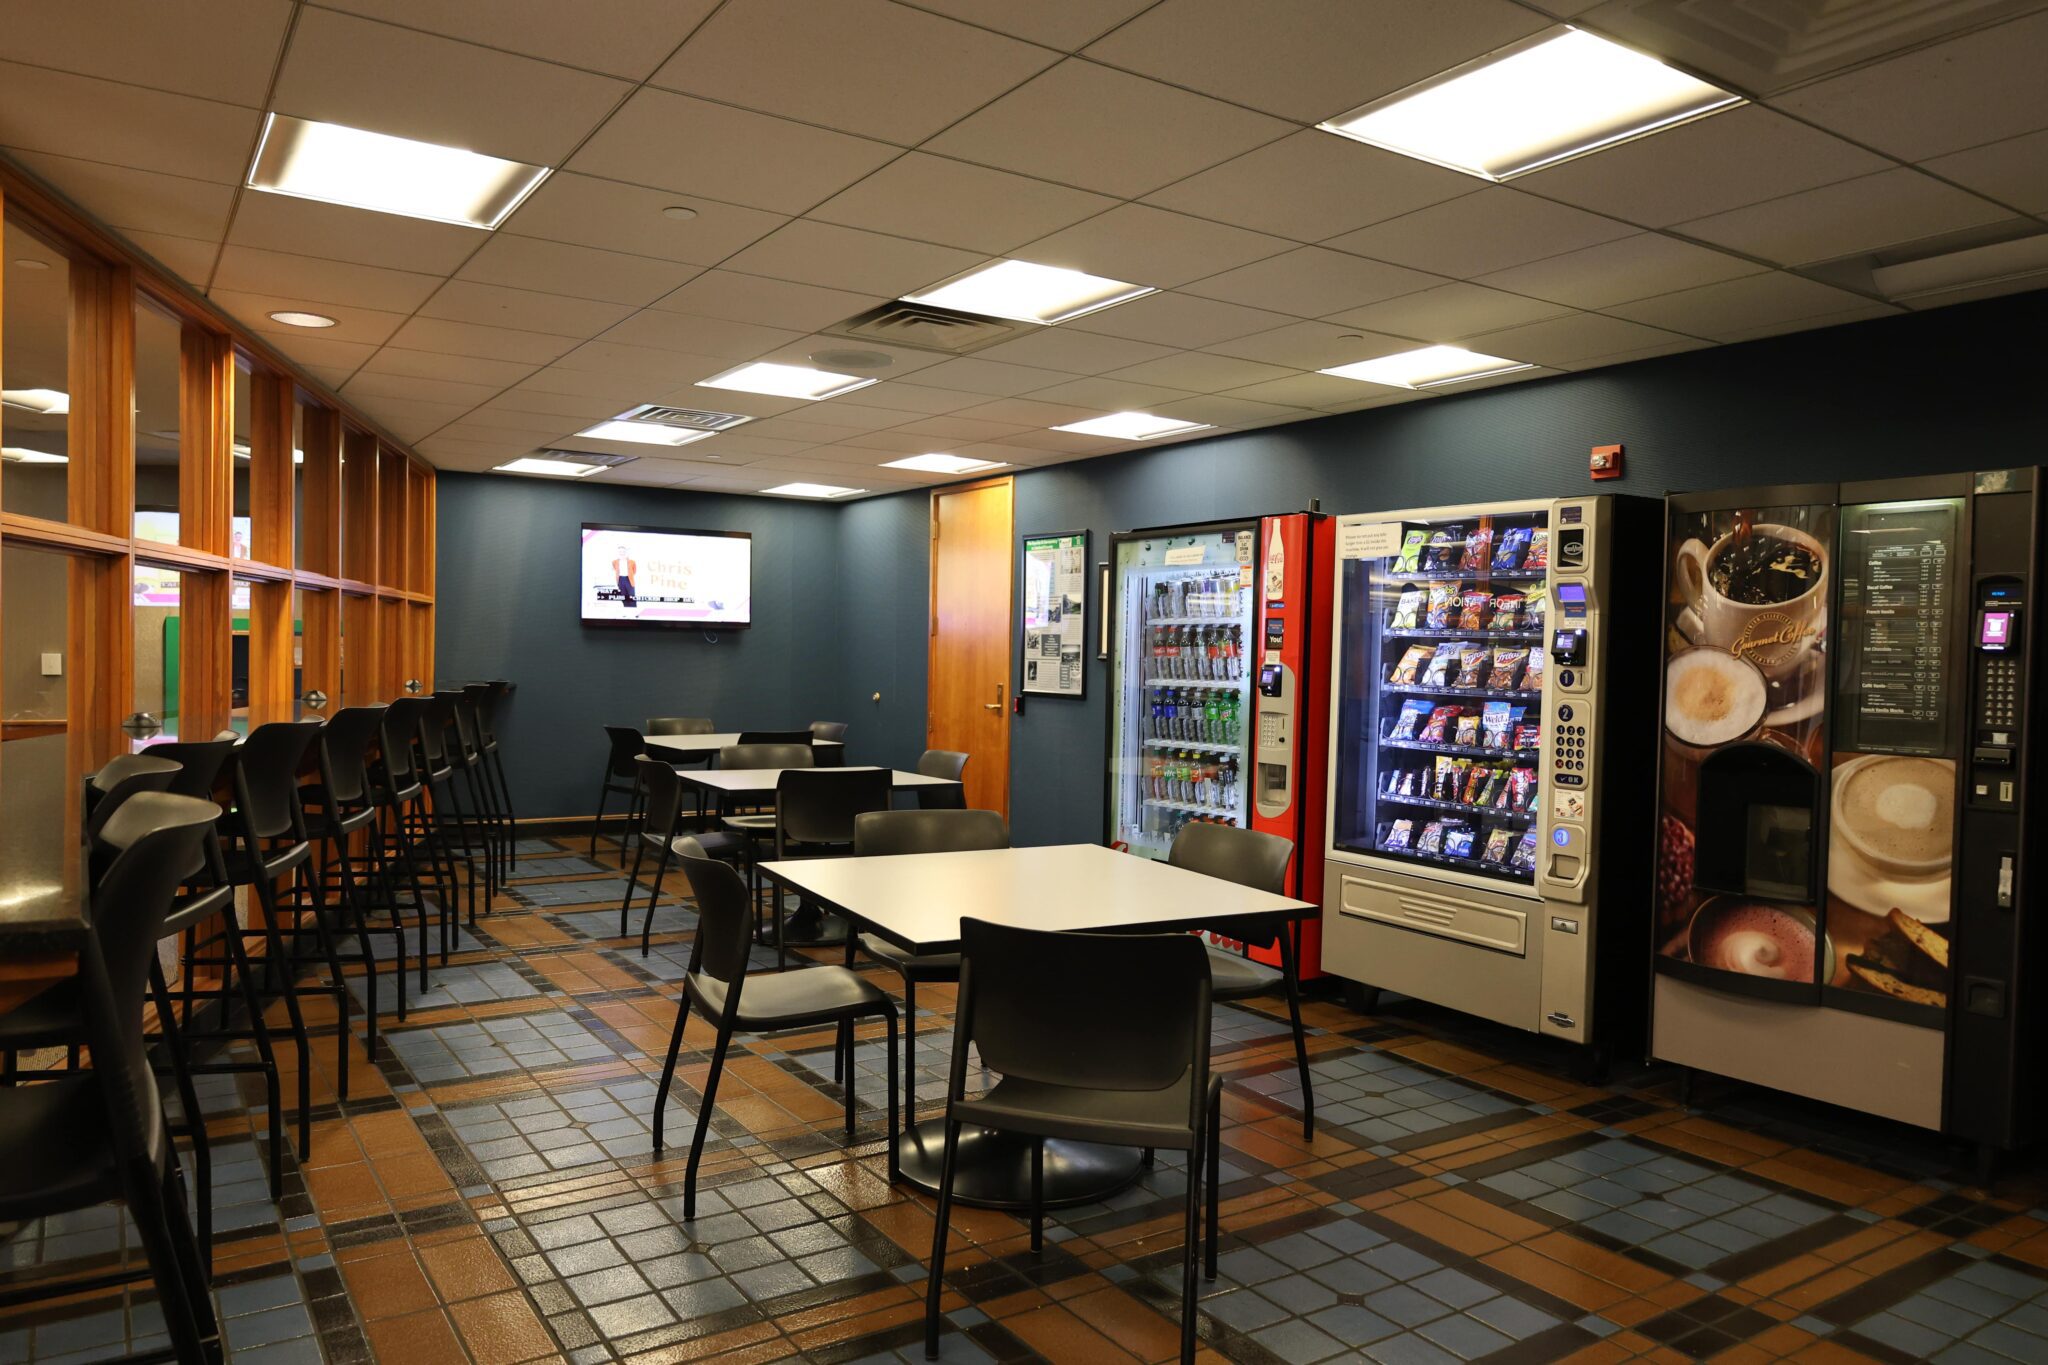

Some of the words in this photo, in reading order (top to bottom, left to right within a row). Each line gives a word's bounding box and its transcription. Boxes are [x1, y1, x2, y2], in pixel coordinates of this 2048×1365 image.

[647, 559, 693, 576] Chris
[650, 574, 688, 590] Pine
[1731, 631, 1780, 660] Gourmet
[1780, 621, 1816, 645] Coffee
